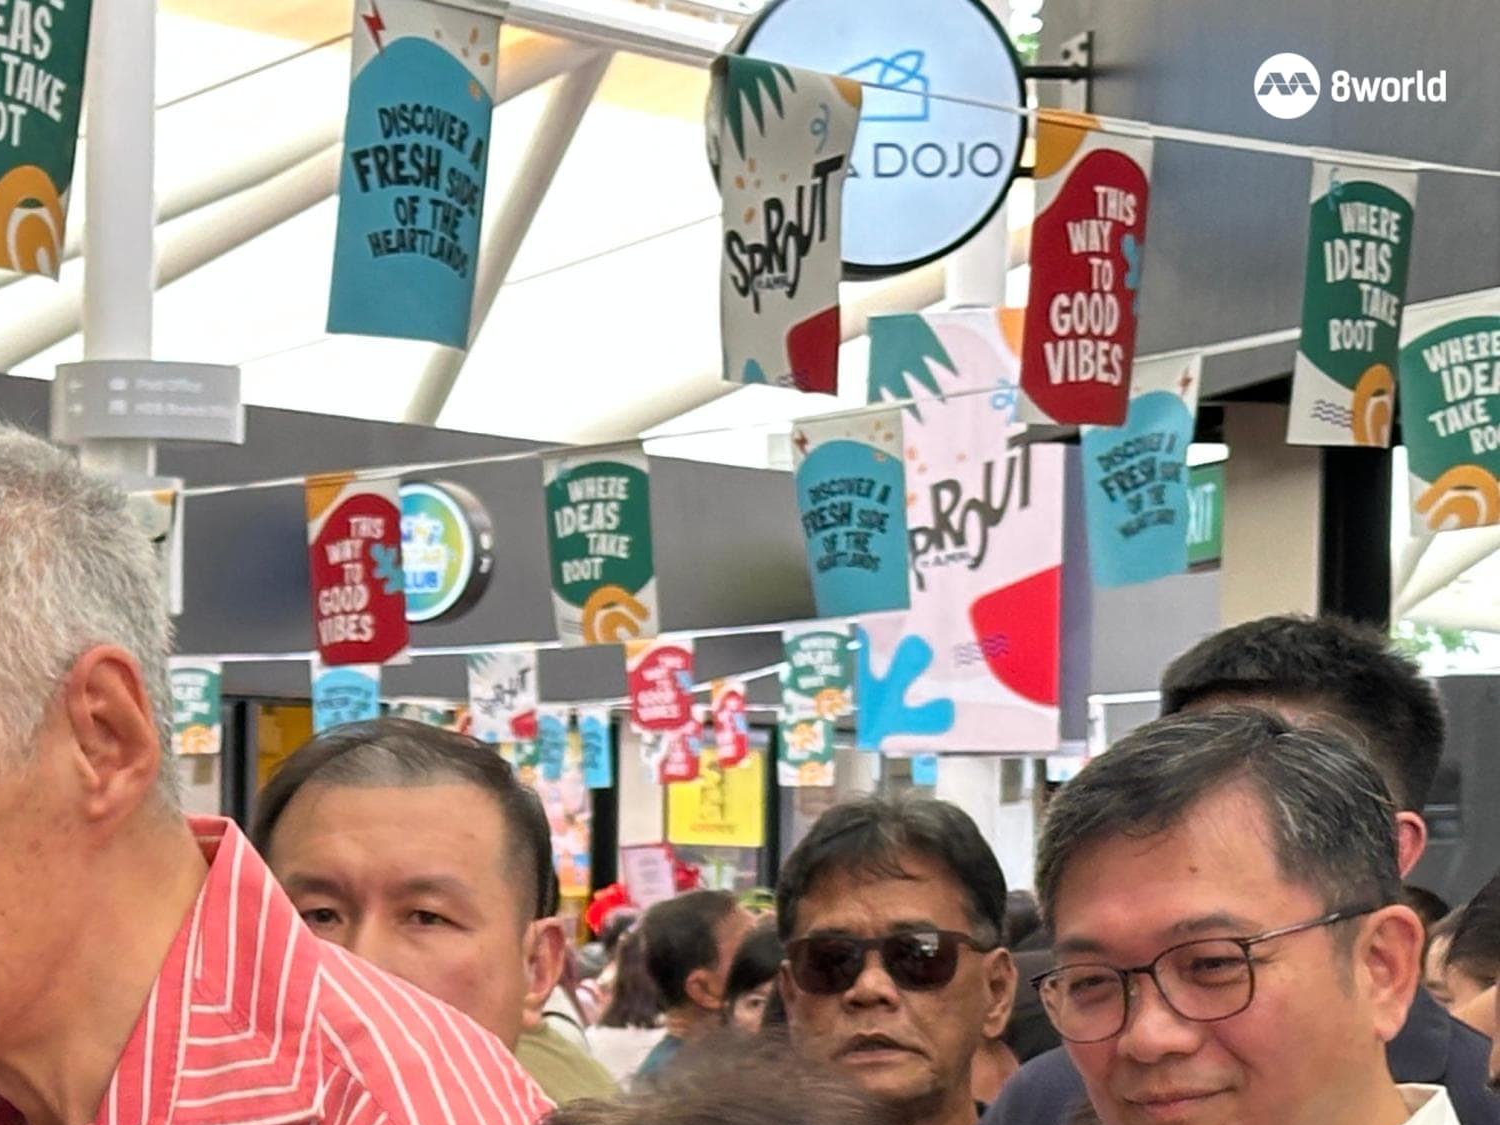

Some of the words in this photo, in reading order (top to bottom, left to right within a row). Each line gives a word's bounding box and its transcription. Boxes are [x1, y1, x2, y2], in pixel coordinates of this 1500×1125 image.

[1, 52, 66, 123] TAKE
[377, 103, 469, 155] DISCOVER
[351, 143, 442, 193] FRESH
[874, 142, 1002, 178] DOJO
[394, 195, 421, 227] OF
[429, 198, 464, 241] THE
[1093, 185, 1137, 226] THIS
[1339, 201, 1402, 244] WHERE
[367, 228, 469, 279] HEARTLANDS
[725, 155, 845, 314] SPROUT
[1066, 219, 1114, 254] WAY
[1088, 257, 1114, 292] TO
[1324, 239, 1393, 284] IDEAS
[1050, 293, 1120, 337] GOOD
[1358, 283, 1399, 327] TAKE
[1328, 319, 1377, 352] ROOT
[1422, 330, 1500, 373] WHERE
[1044, 340, 1124, 386] VIBES
[1427, 397, 1491, 437] TAKE
[567, 476, 630, 503] WHERE
[349, 517, 385, 539] THIS
[554, 501, 620, 538] IDEAS
[325, 537, 365, 565] WAY
[586, 532, 631, 559] TAKE
[342, 562, 364, 585] TO
[561, 557, 603, 585] ROOT
[319, 583, 370, 617] GOOD
[318, 613, 375, 646] VIBES
